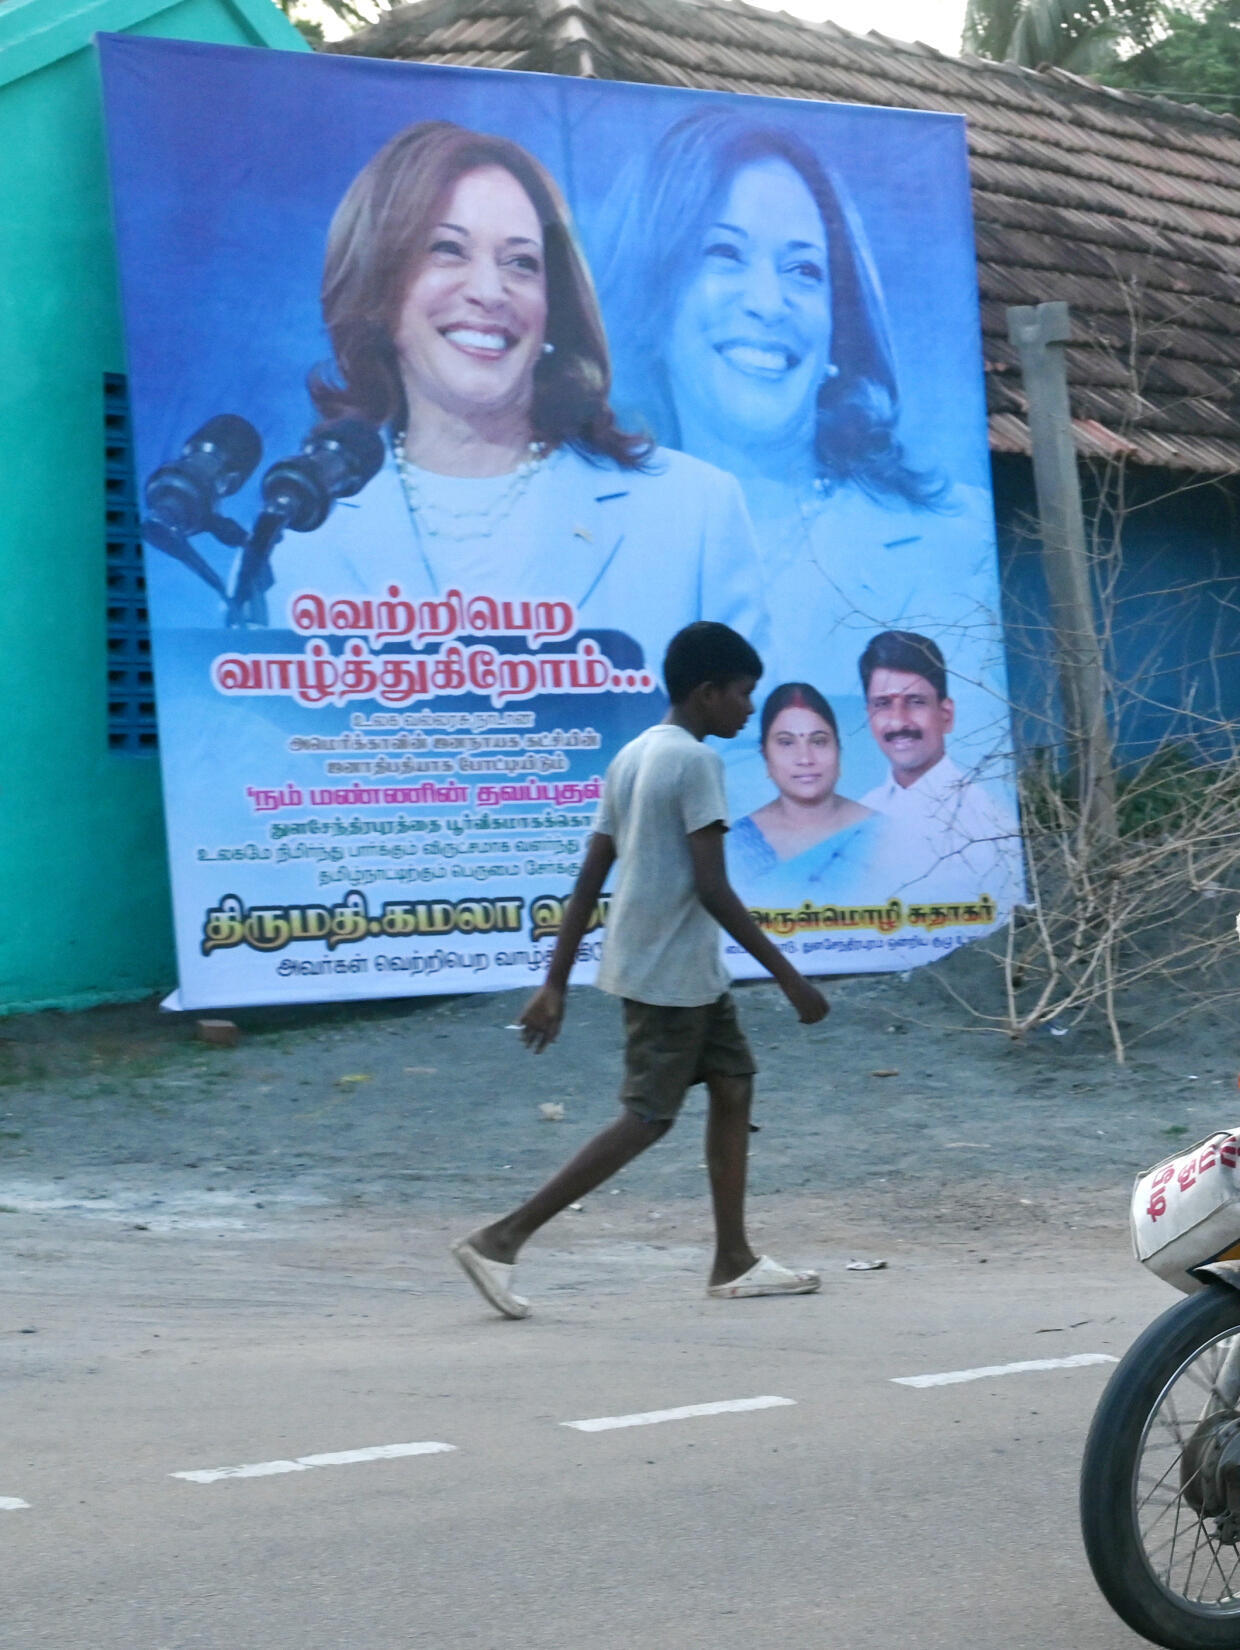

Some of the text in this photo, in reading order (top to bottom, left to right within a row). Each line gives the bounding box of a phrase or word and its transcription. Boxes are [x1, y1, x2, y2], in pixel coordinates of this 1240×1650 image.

[293, 585, 574, 640] வெற்றிபெற
[218, 644, 654, 701] வாழ்த்துகிறோம்...
[908, 894, 995, 928] சுதாகர்
[277, 953, 368, 977] அவர்கள்
[374, 949, 489, 976] வெற்றிபெற
